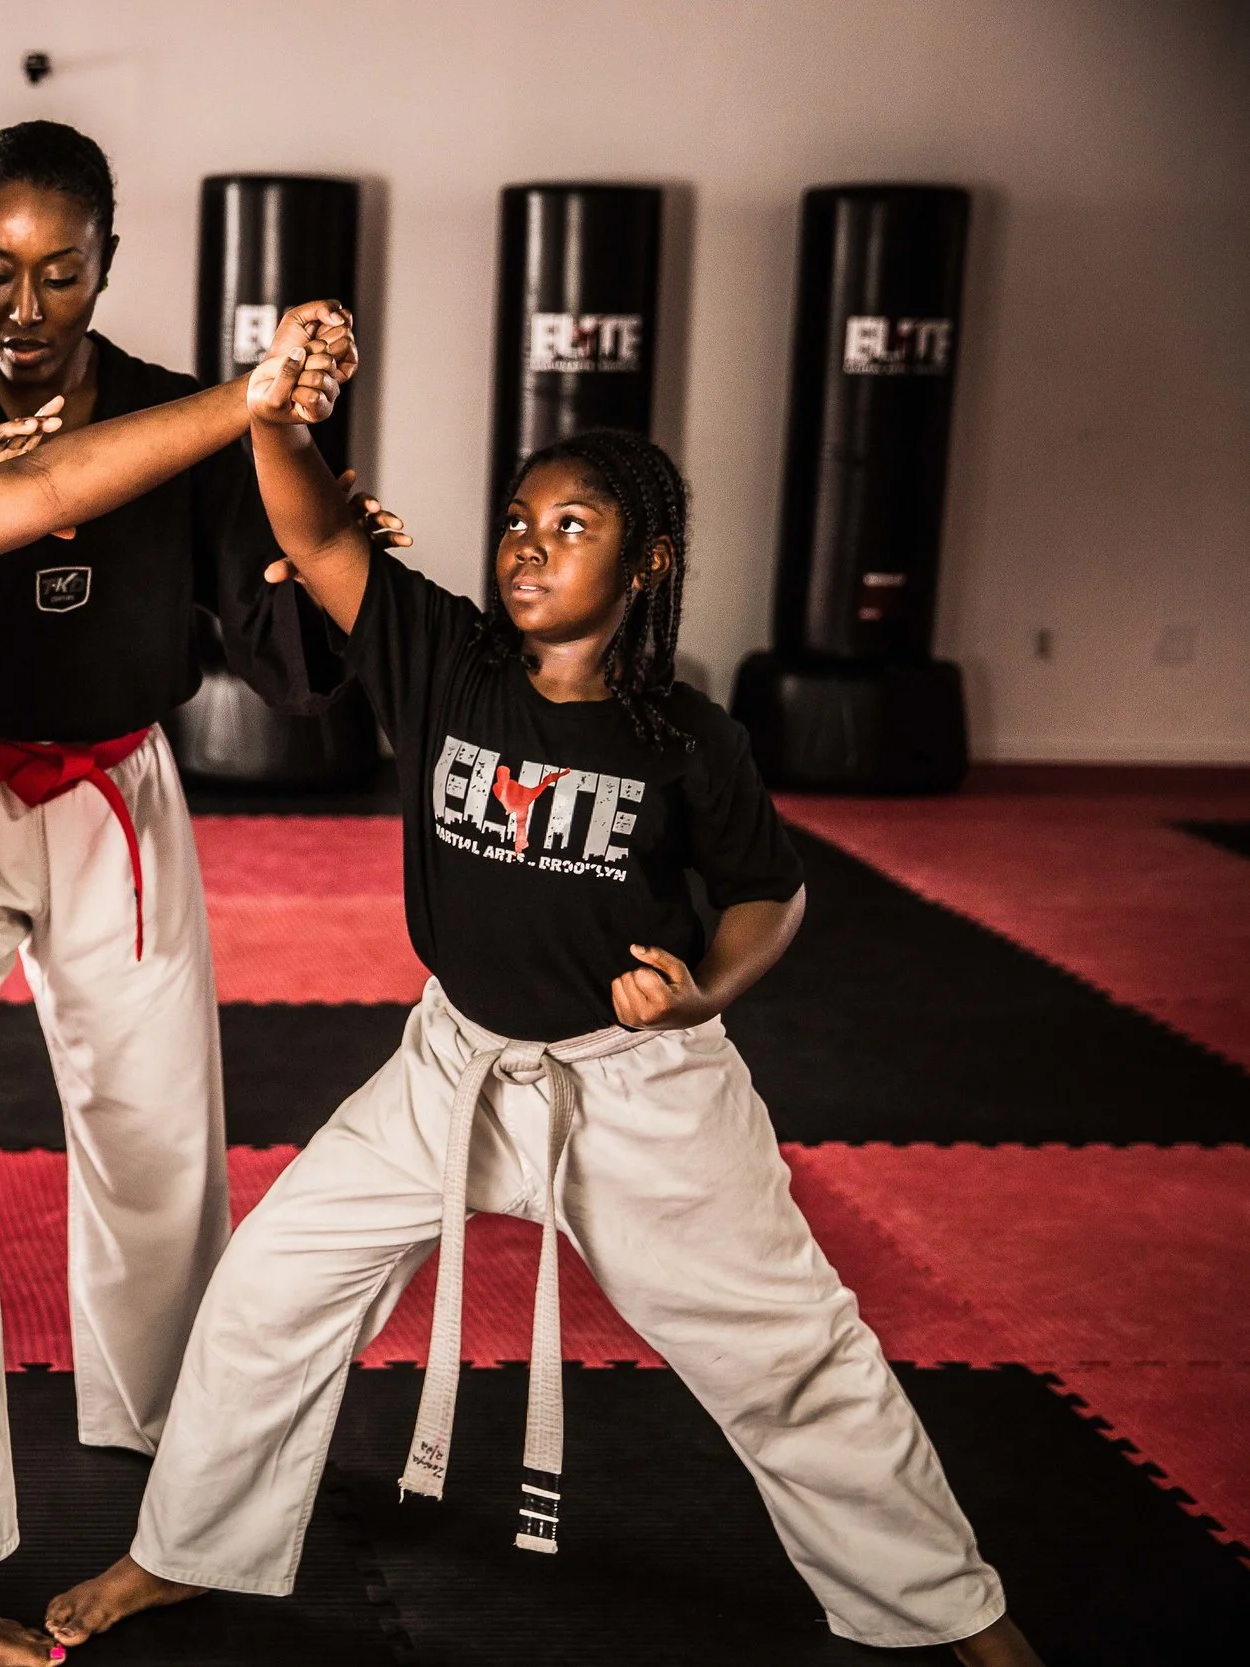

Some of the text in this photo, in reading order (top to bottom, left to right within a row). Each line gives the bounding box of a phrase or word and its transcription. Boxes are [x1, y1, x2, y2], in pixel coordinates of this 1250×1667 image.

[432, 735, 646, 862] ELYTE
[483, 845, 526, 863] ARTS
[538, 856, 628, 882] BROOKLYN
